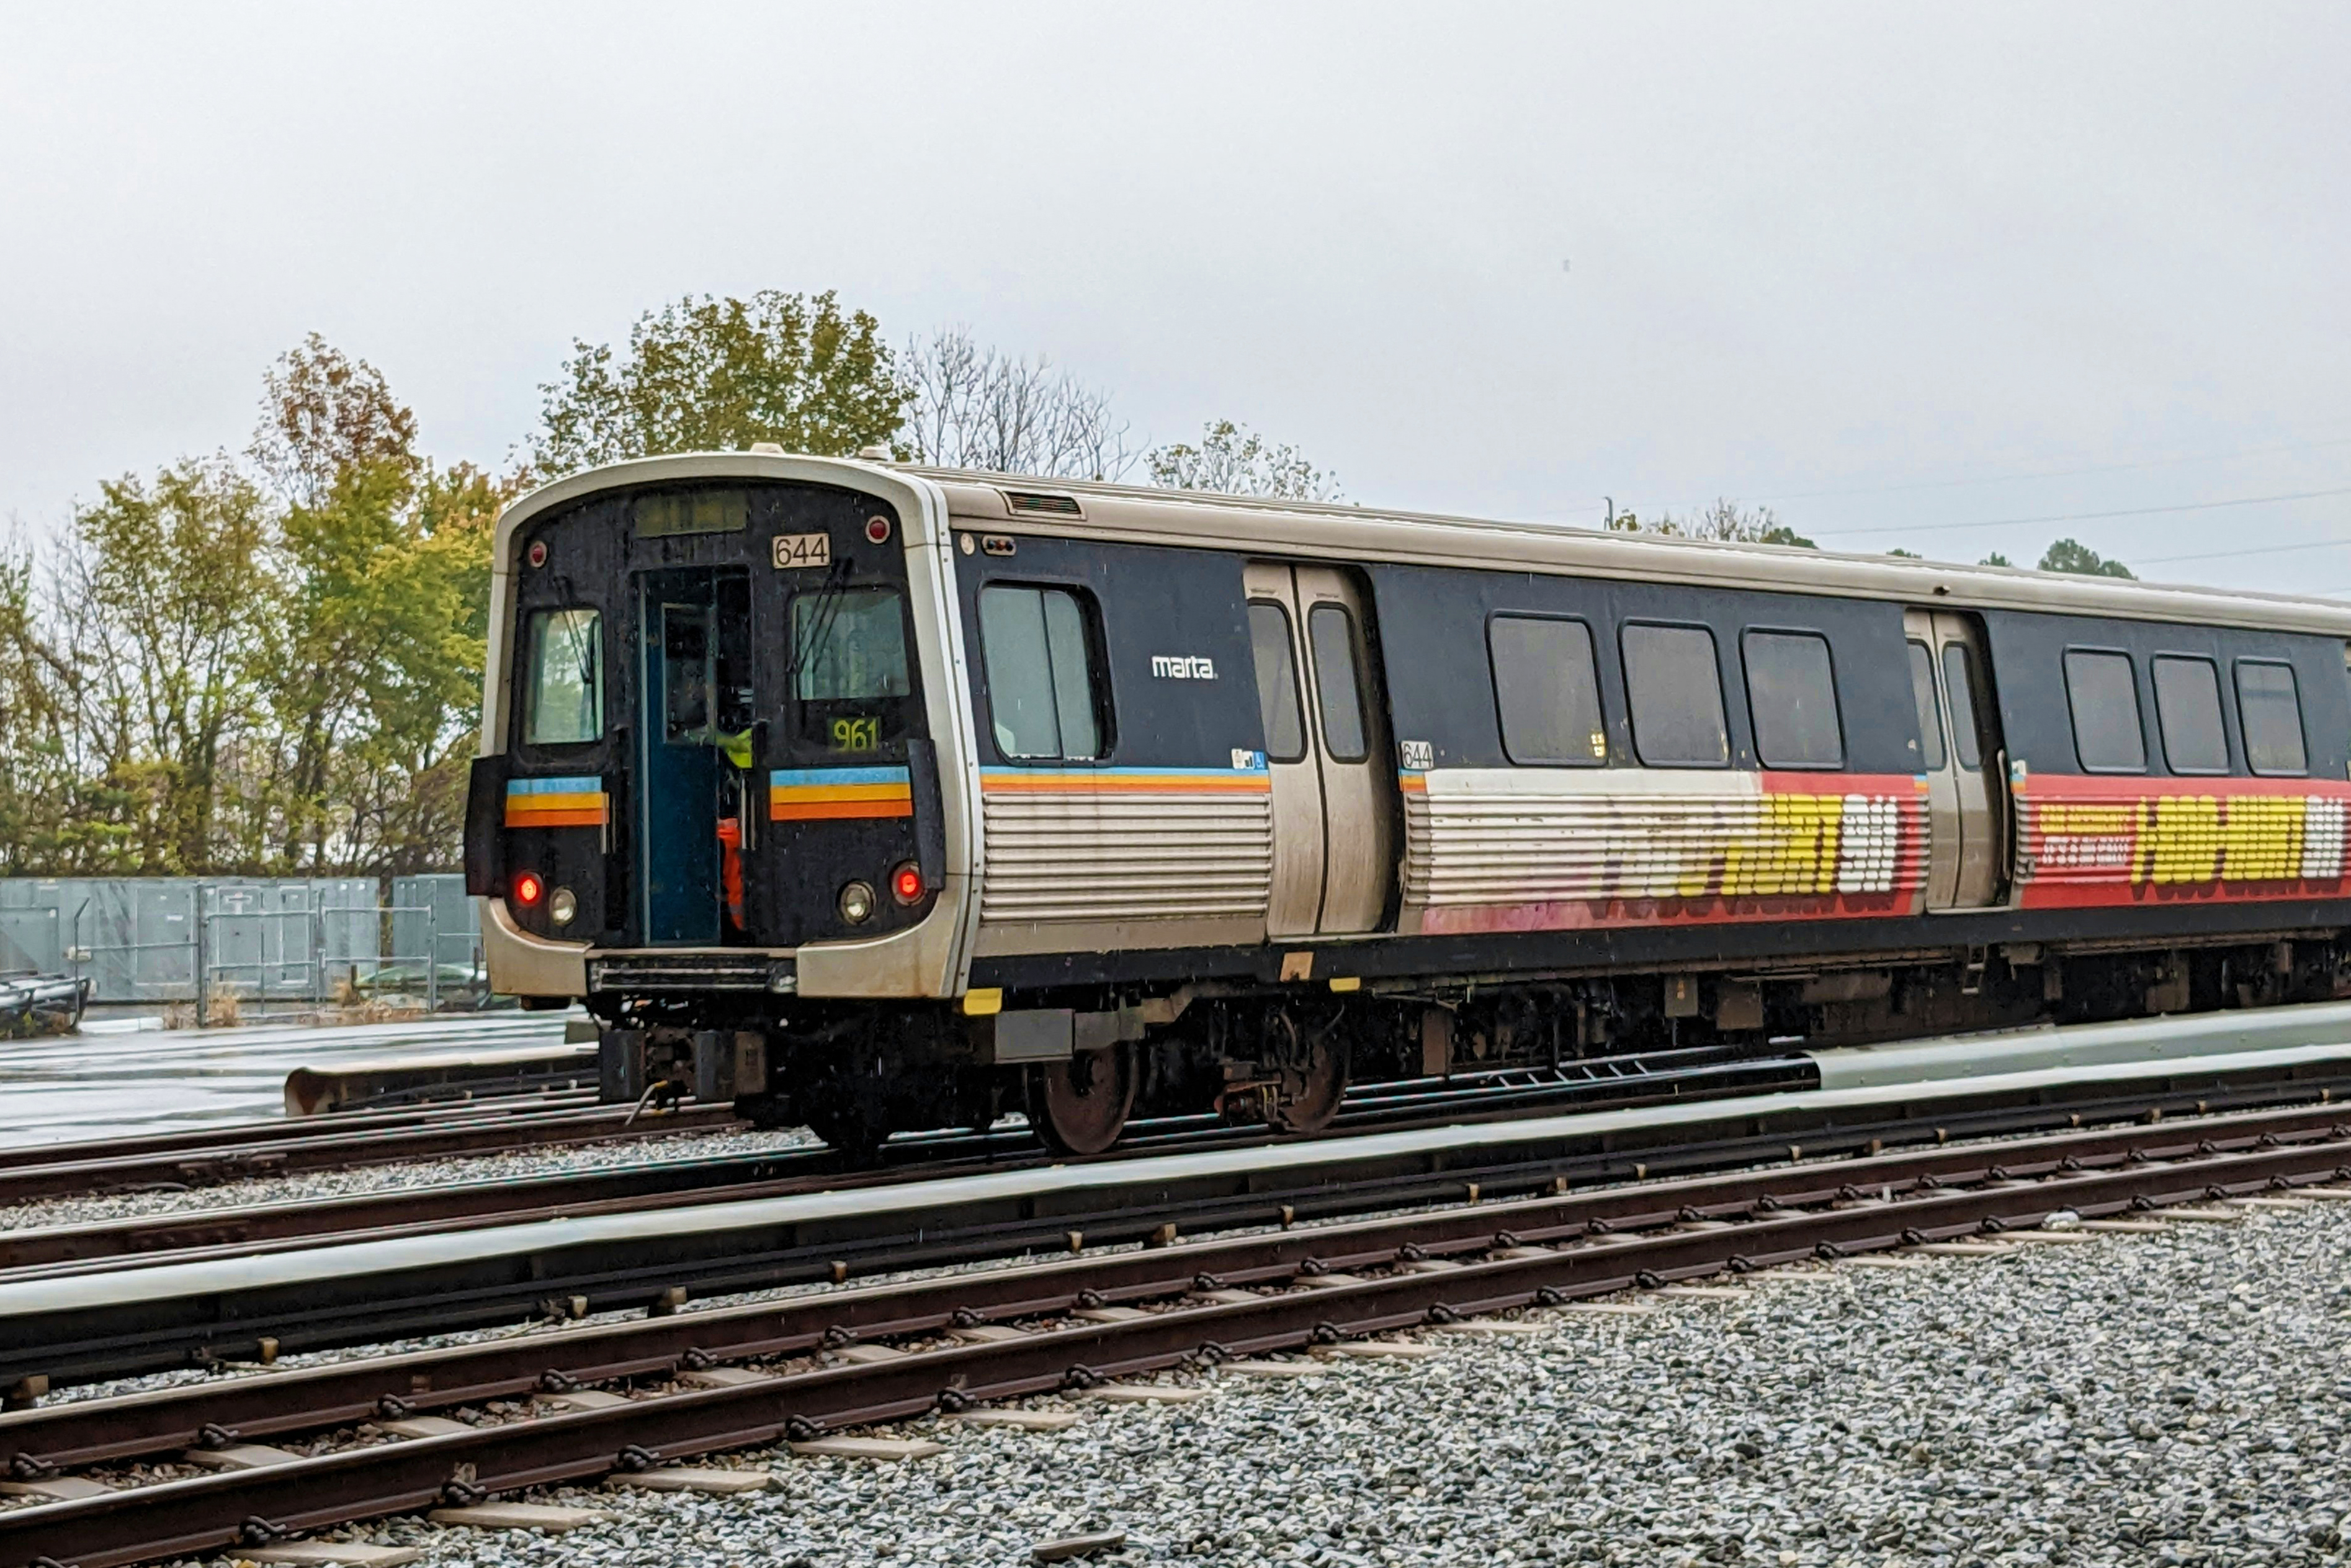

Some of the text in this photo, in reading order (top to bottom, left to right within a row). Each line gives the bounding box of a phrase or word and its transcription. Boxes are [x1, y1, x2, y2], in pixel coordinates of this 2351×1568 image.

[776, 536, 827, 565] 644
[1152, 656, 1214, 679] marta
[833, 719, 877, 751] 961
[1404, 743, 1431, 768] 644
